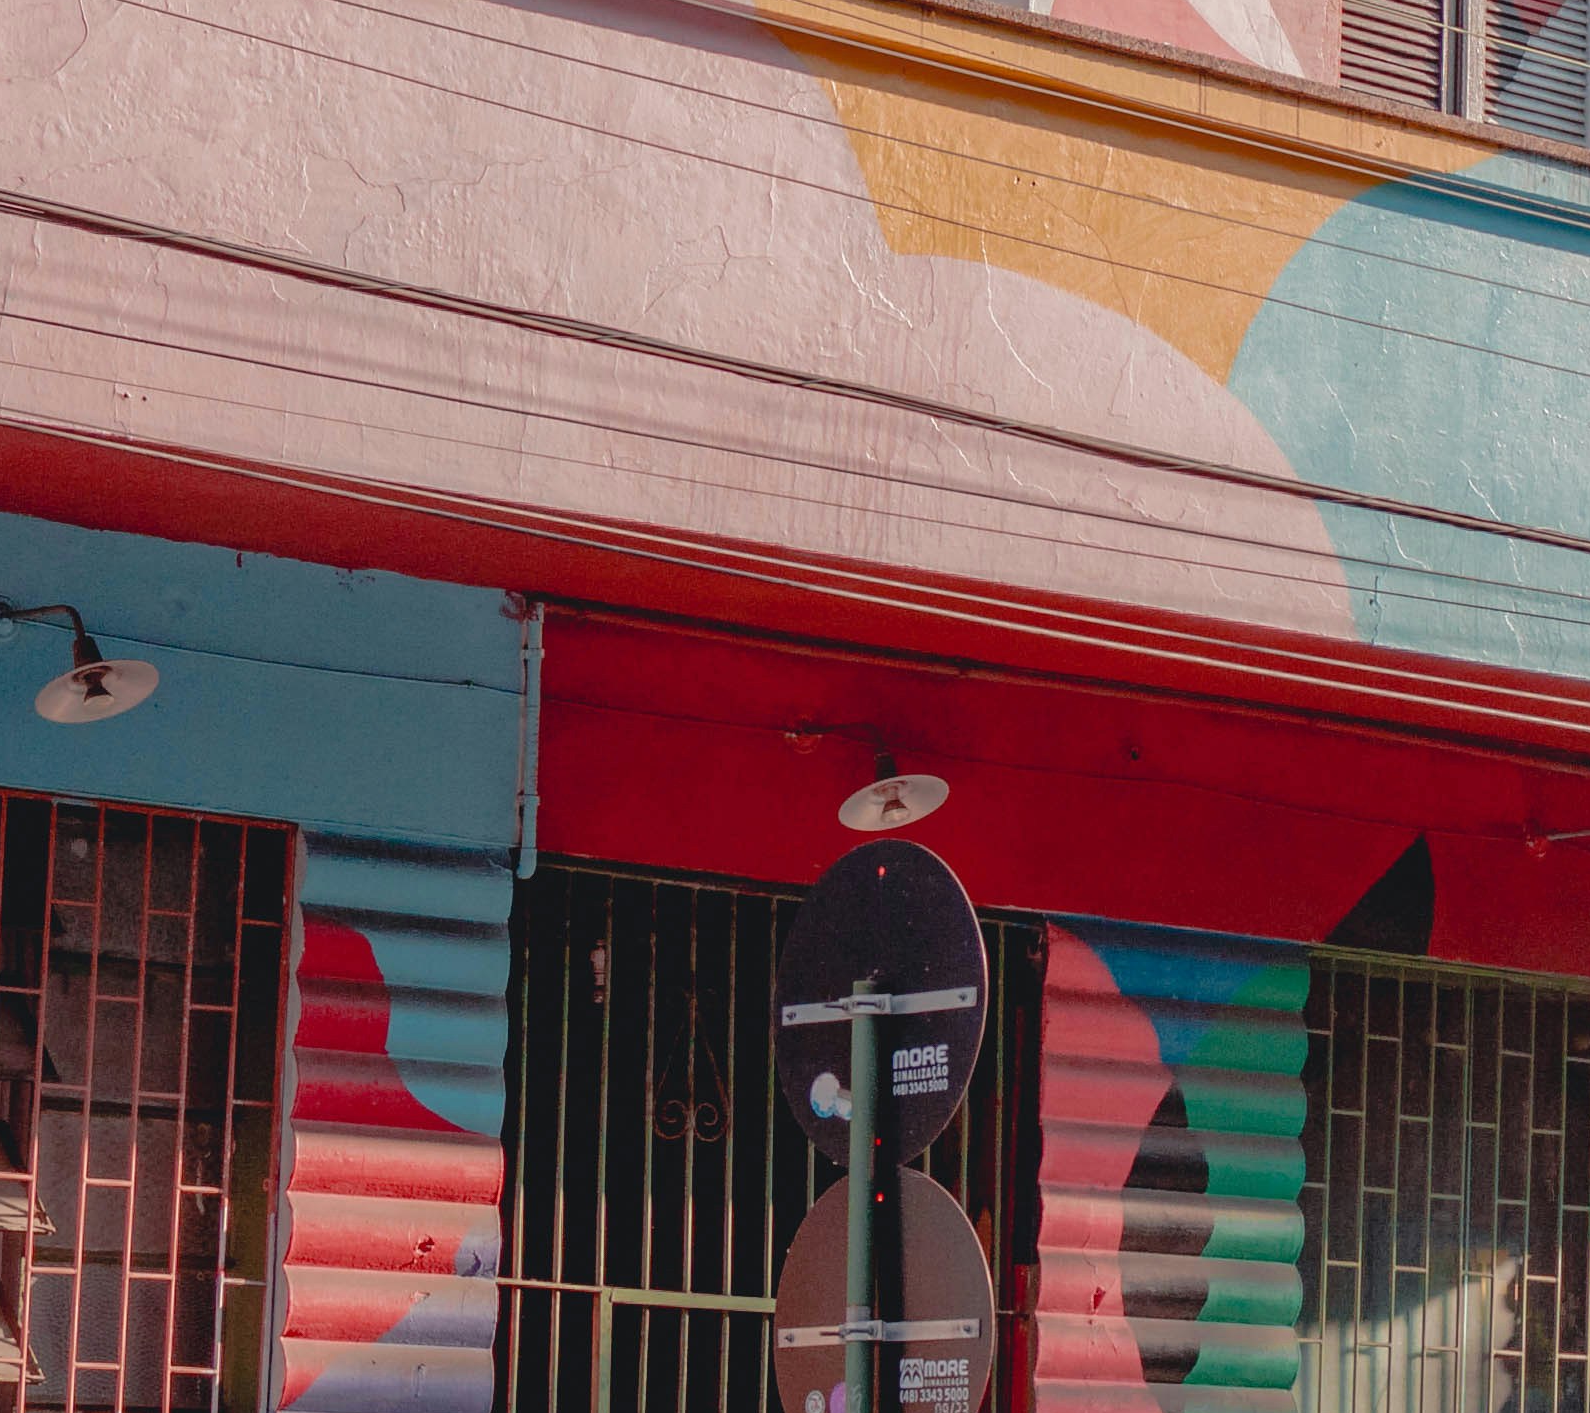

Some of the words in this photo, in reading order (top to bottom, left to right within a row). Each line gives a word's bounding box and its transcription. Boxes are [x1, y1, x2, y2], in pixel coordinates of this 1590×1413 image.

[893, 1044, 949, 1070] MORE
[893, 1064, 949, 1083] SINALIZAÇÃO
[924, 1358, 970, 1377] MORE
[899, 1388, 918, 1404] (48)
[919, 1387, 943, 1403] 3343
[944, 1386, 969, 1402] 5000
